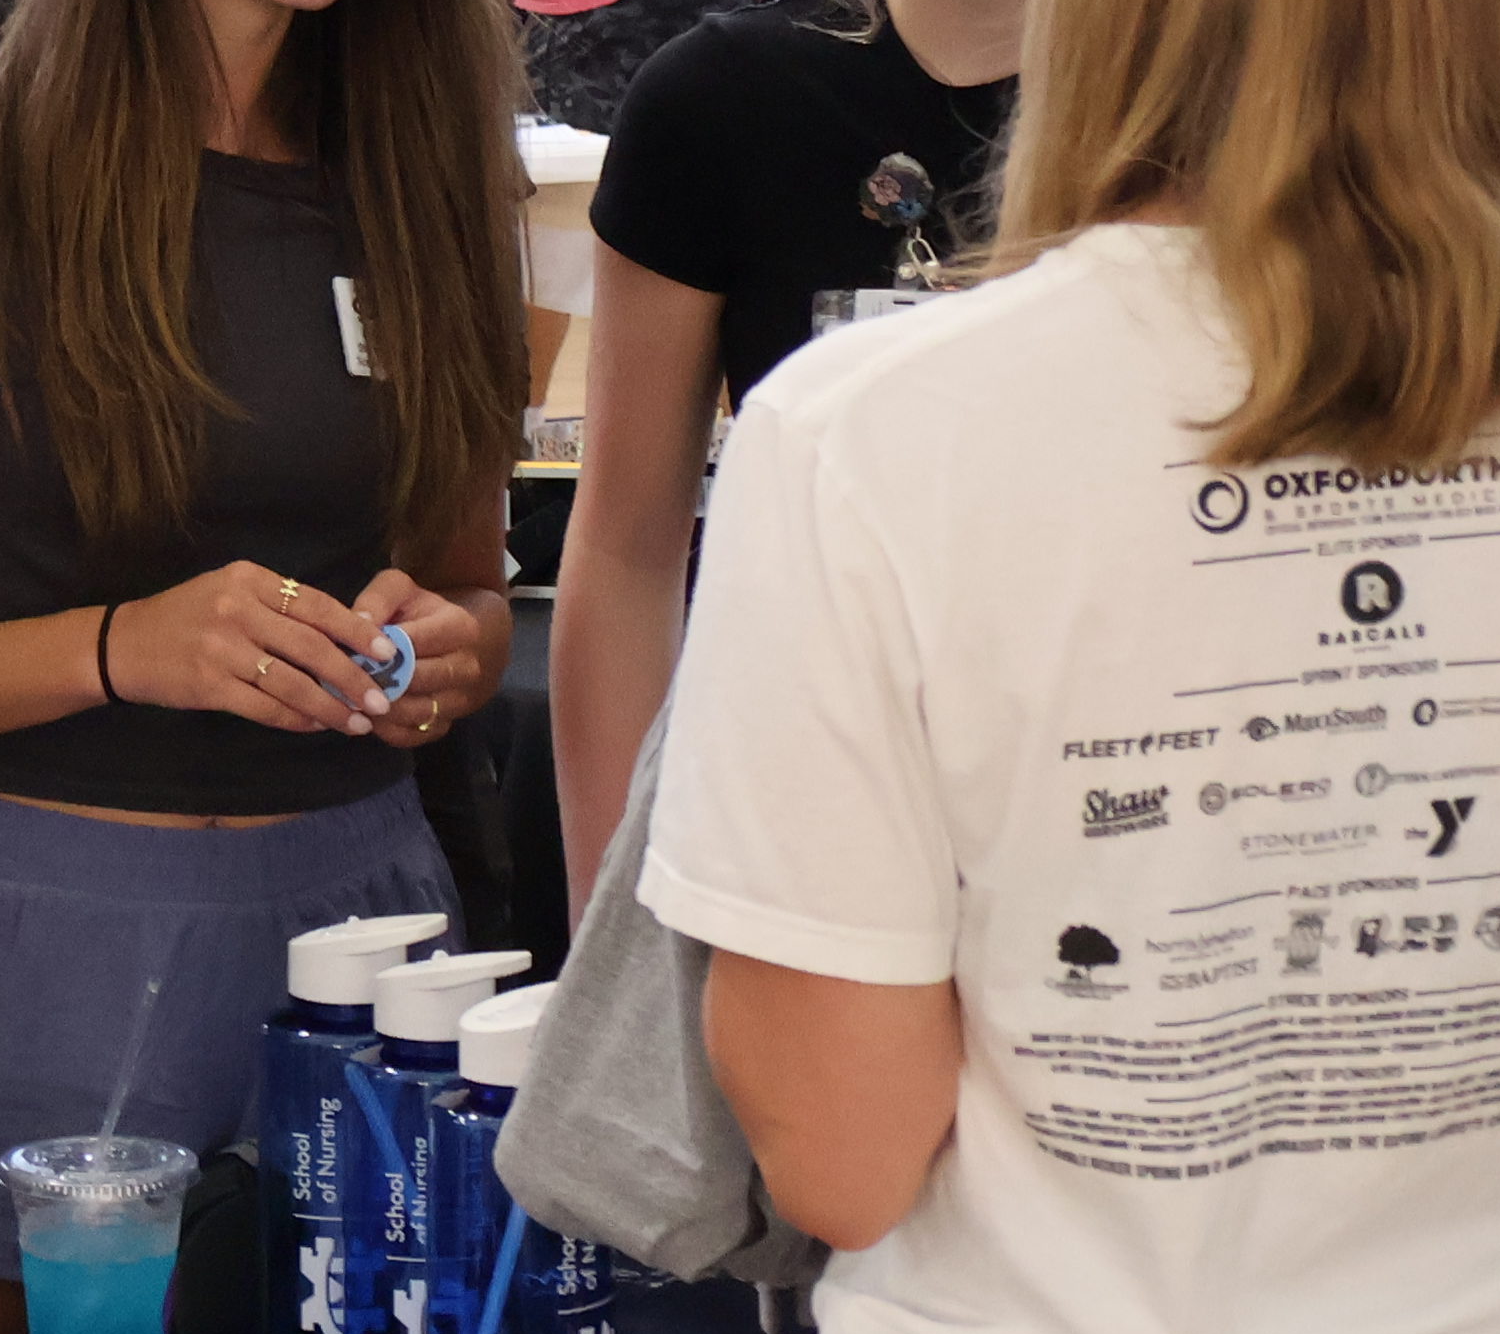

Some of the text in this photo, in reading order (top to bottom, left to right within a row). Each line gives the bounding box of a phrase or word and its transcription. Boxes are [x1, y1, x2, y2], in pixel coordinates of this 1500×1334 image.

[1318, 622, 1427, 647] RASCALS
[1063, 727, 1220, 761] FLEET FEET
[292, 1132, 311, 1203] School
[316, 1098, 342, 1204] of Nursing
[385, 1173, 405, 1244] School
[557, 1234, 578, 1296] Scho
